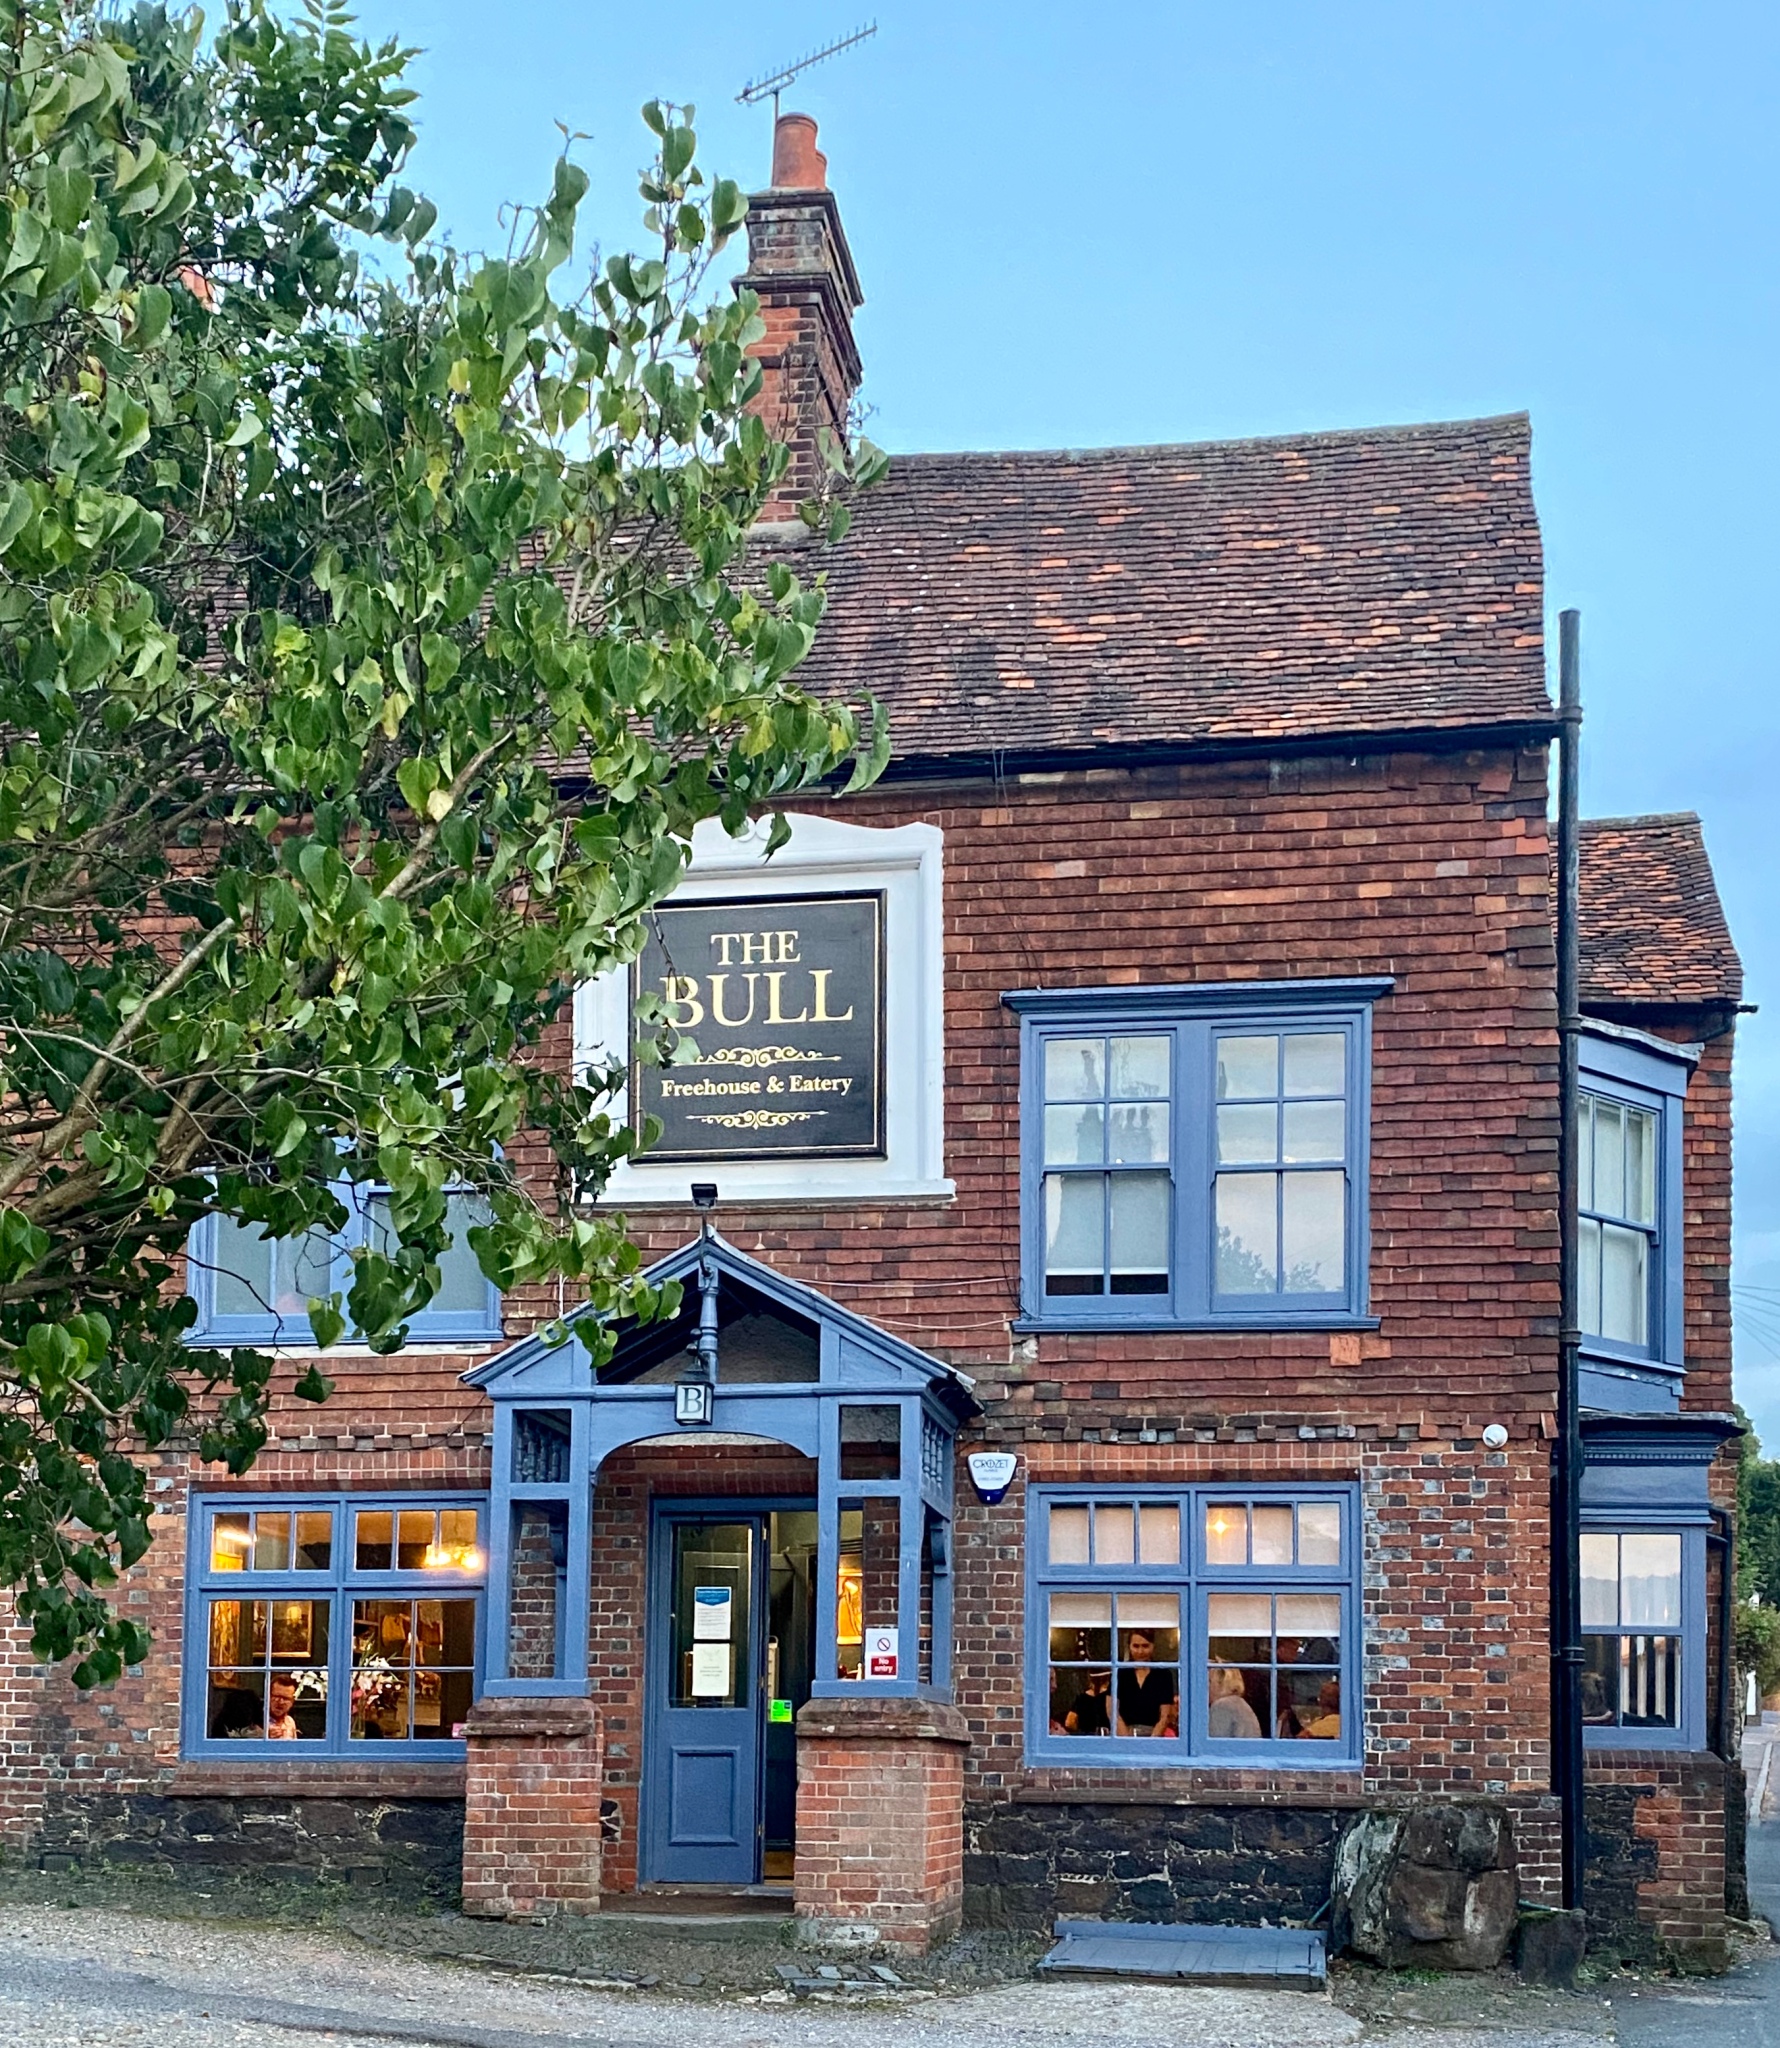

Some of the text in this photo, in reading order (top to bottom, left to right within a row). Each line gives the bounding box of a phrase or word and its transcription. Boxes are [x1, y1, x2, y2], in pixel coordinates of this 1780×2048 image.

[710, 930, 801, 966] THE
[659, 969, 853, 1028] BULL
[661, 1074, 853, 1097] Freehouse & Eatery
[680, 1386, 703, 1414] B
[972, 1459, 1009, 1469] CROZET
[874, 1664, 894, 1674] entry
[878, 1657, 890, 1665] No
